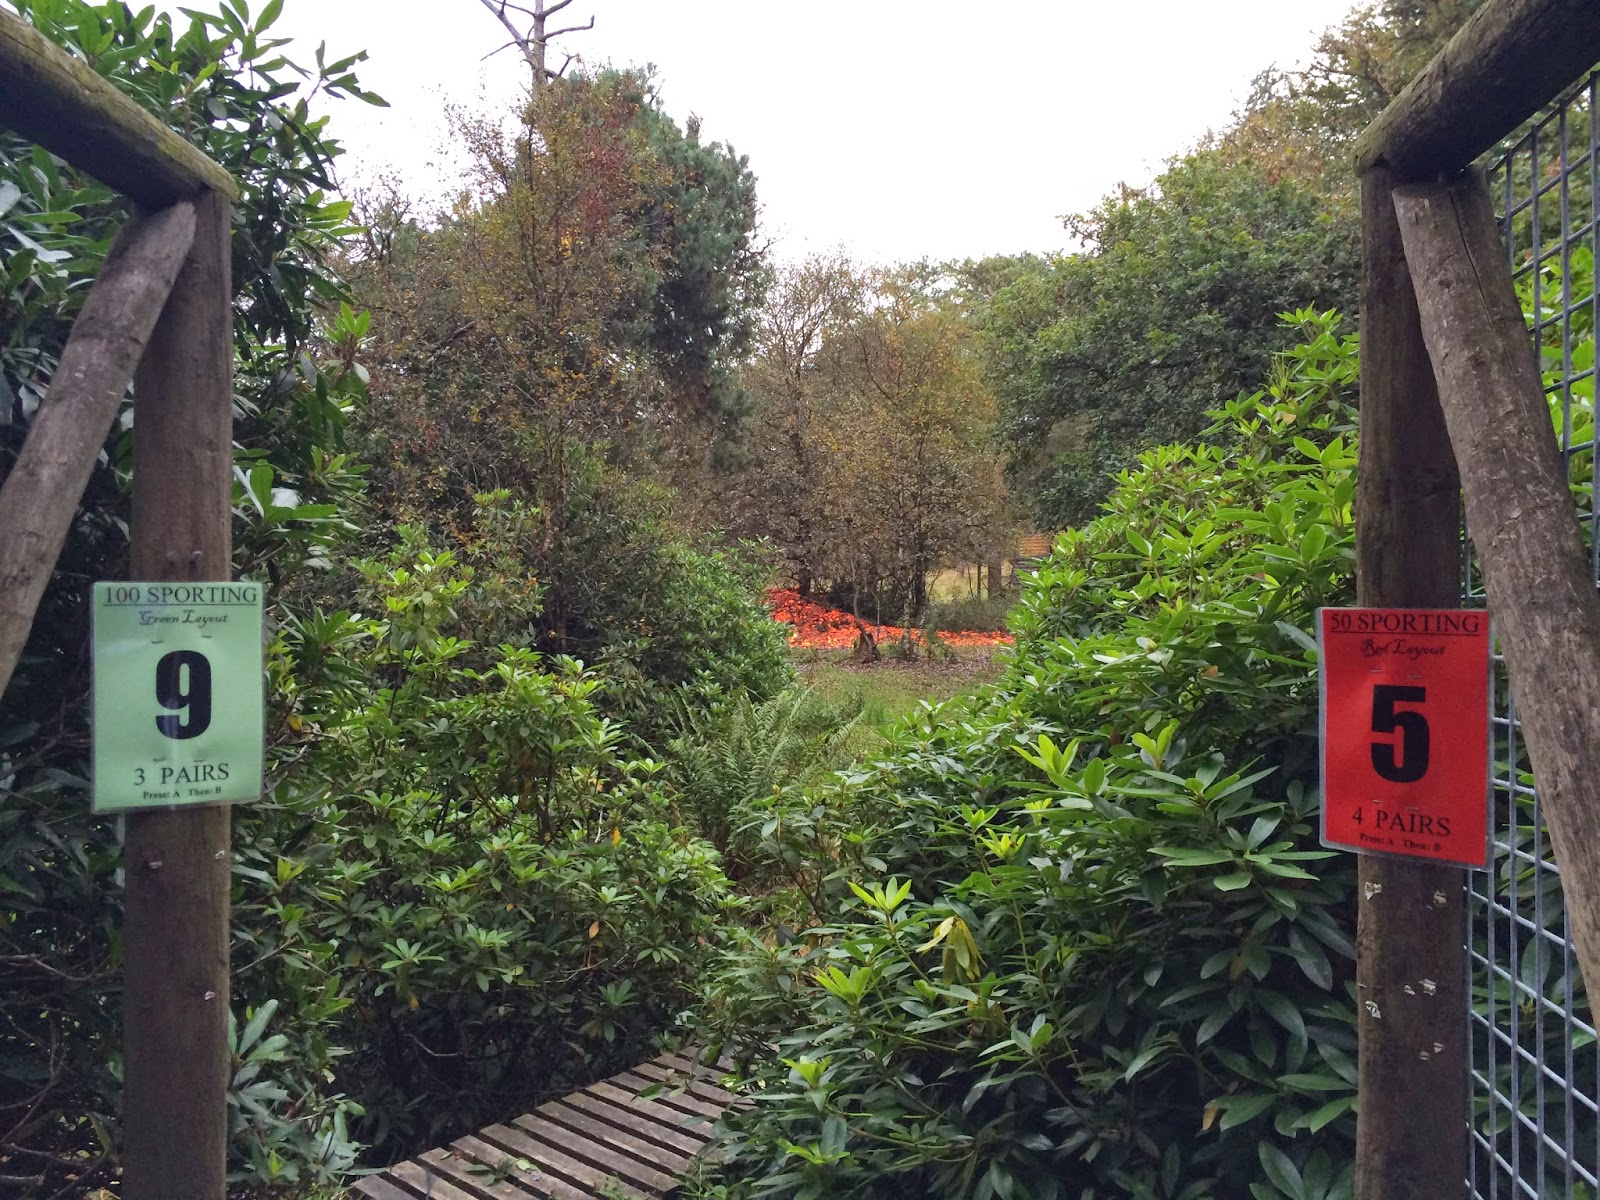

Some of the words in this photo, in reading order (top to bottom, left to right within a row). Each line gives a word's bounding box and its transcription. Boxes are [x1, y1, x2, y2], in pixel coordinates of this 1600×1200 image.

[106, 587, 140, 603] 100
[147, 587, 257, 603] SPORTING
[138, 610, 179, 626] Green
[182, 609, 228, 628] Layout
[1331, 613, 1351, 630] 50
[1358, 613, 1480, 633] SPORTING
[1362, 638, 1392, 657] Red
[1392, 638, 1445, 660] Layout
[155, 650, 212, 740] 9
[1371, 684, 1430, 783] 5
[134, 768, 145, 786] 3
[160, 763, 229, 784] PAIRS
[173, 790, 180, 798] A
[215, 786, 222, 794] B
[1352, 807, 1363, 825] 4
[1376, 809, 1451, 837] PAIRS
